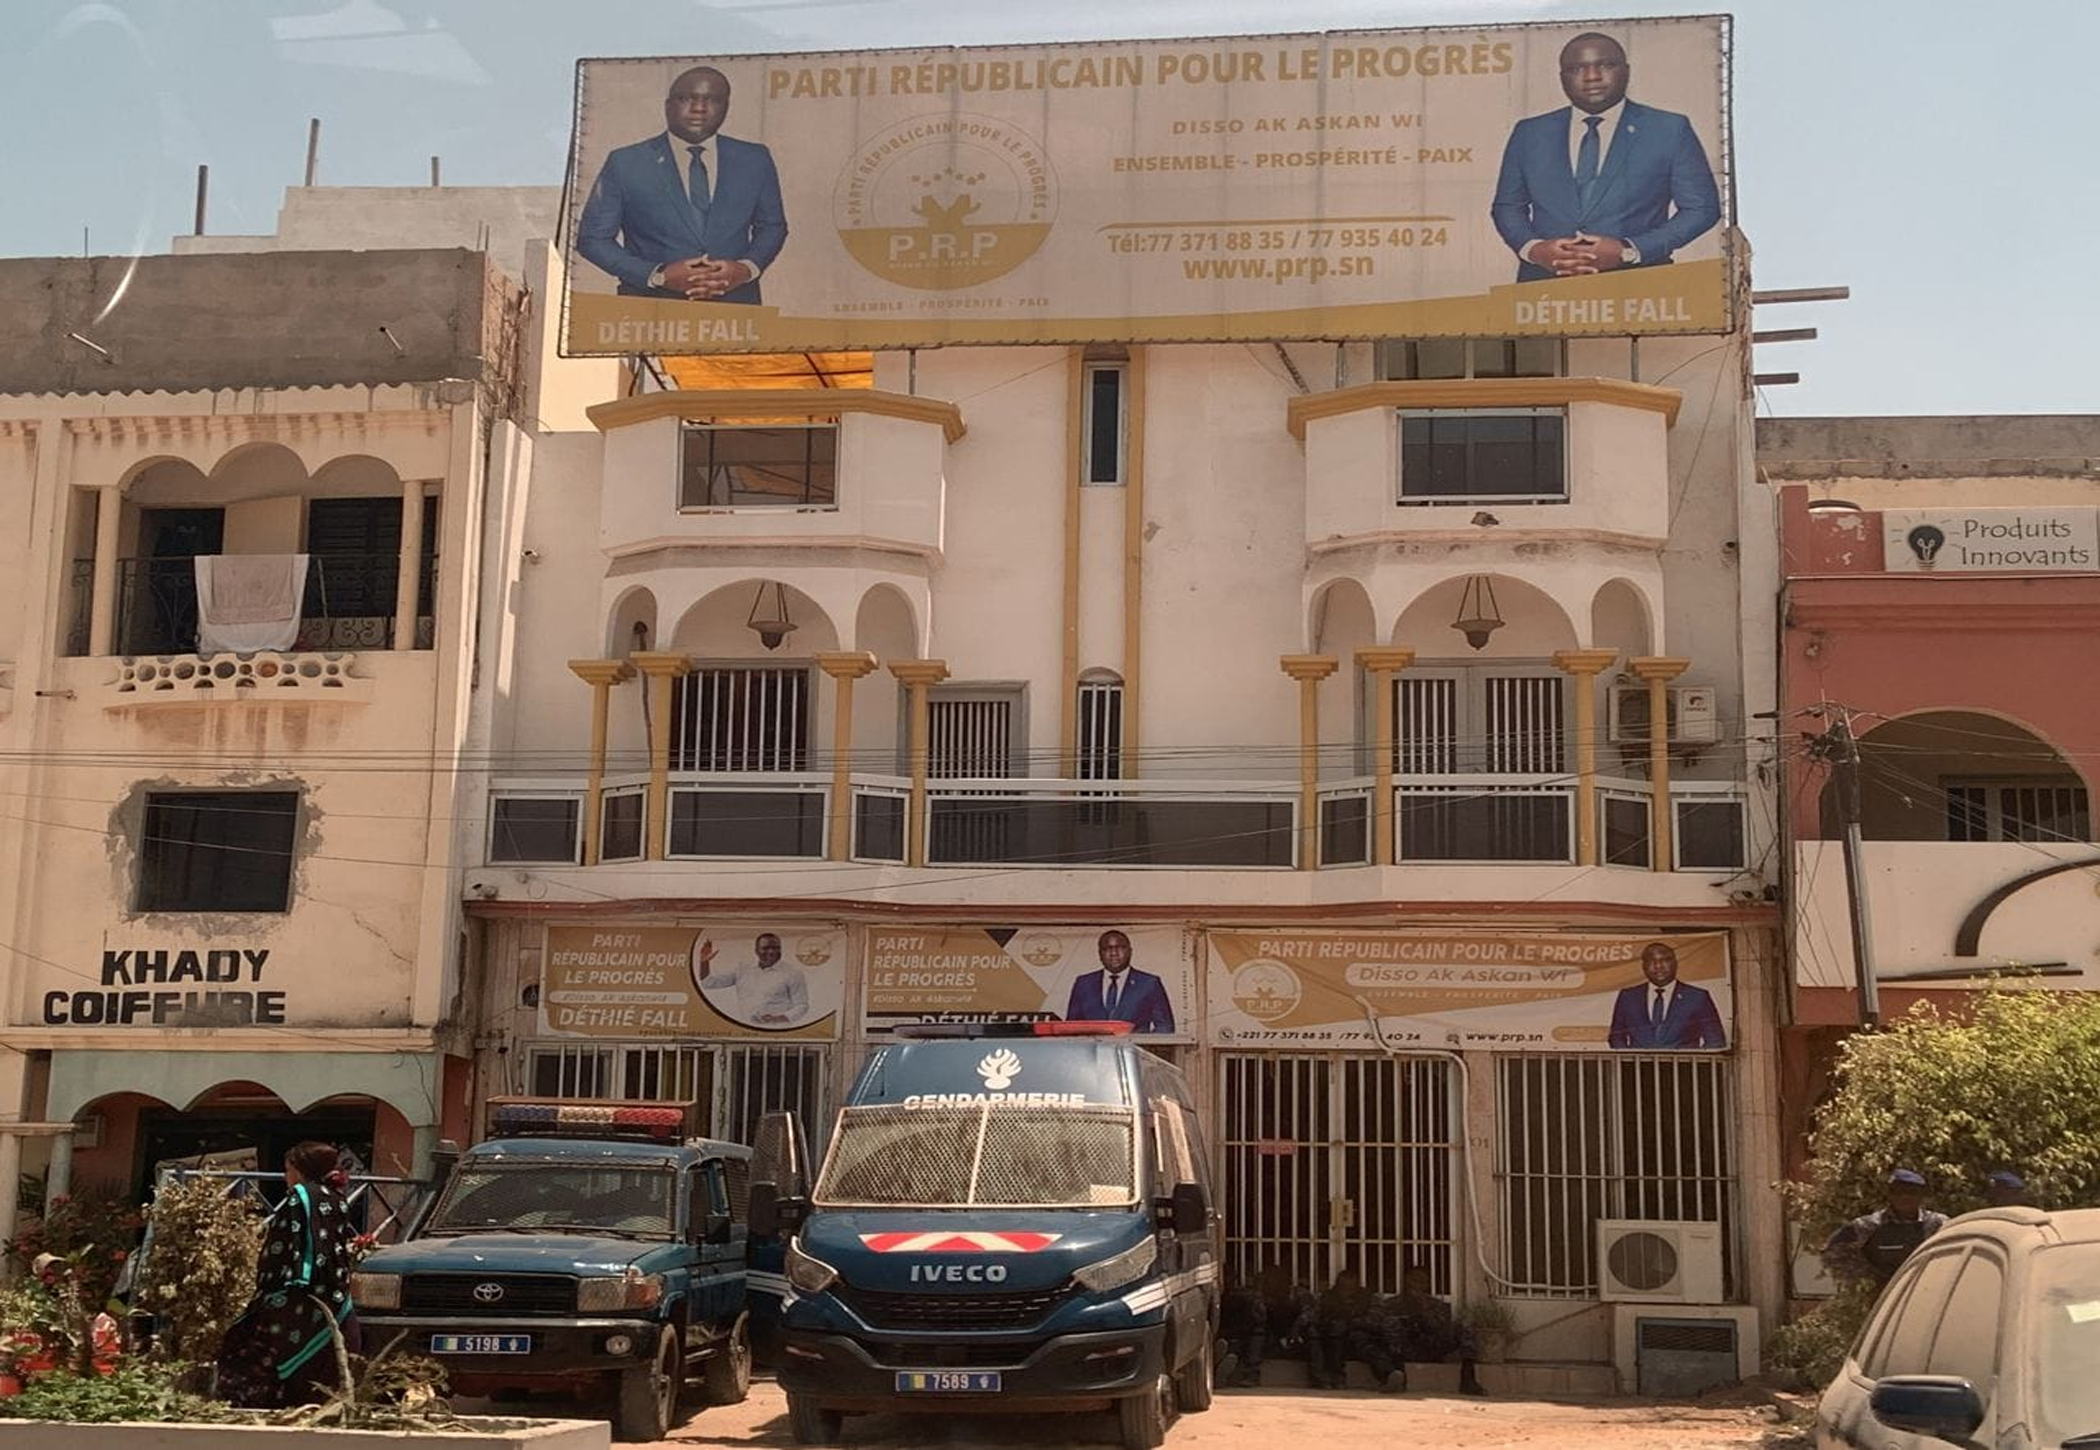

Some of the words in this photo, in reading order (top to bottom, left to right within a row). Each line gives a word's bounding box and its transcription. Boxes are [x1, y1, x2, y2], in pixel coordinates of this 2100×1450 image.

[769, 66, 878, 99] PARTI
[889, 54, 1143, 95] RÉPUBLICAIN
[1157, 51, 1266, 86] POUR
[1277, 49, 1319, 81] LE
[1331, 34, 1513, 79] PROGRÈS
[1172, 119, 1245, 135] DISSO
[1254, 117, 1288, 132] AK
[1295, 114, 1382, 131] ASKAN
[1390, 113, 1423, 129] WI
[958, 121, 1001, 142] POUR
[1002, 136, 1023, 154] LE
[1112, 154, 1237, 173] ENSEMBLE
[1255, 146, 1397, 169] PROSPÉRITÉ
[1416, 147, 1474, 165] PAIX
[889, 231, 998, 262] P.R.P
[1107, 232, 1174, 253] Tél:77
[1179, 232, 1219, 252] 371
[1225, 231, 1253, 251] 88
[1258, 230, 1285, 250] 35
[1290, 229, 1301, 249] /
[1307, 229, 1335, 249] 77
[1340, 228, 1381, 248] 935
[1387, 227, 1414, 247] 40
[1420, 226, 1448, 247] 24
[1182, 254, 1375, 286] www.prp.sn
[1515, 293, 1616, 325] DÉTHIE
[1623, 296, 1693, 323] FALL
[597, 314, 691, 345] DÉTHIE
[697, 318, 761, 343] FALL
[1963, 516, 2073, 540] Produits
[1960, 545, 2090, 566] Innovants
[591, 933, 643, 948] PARTI
[875, 936, 925, 951] PARTI
[1259, 940, 1314, 958] PARTI
[1318, 937, 1447, 960] RÉPUBLICAIN
[1451, 943, 1508, 961] POUR
[1513, 944, 1537, 961] LE
[101, 949, 270, 986] KHADY
[551, 948, 644, 967] RÉPUBLICAIN
[646, 952, 687, 968] POUR
[872, 953, 969, 970] RÉPUBLICAIN
[970, 955, 1012, 970] POUR
[563, 970, 585, 984] LE
[873, 972, 894, 987] LE
[1359, 966, 1419, 981] Disso
[1425, 968, 1455, 982] Ak
[1462, 969, 1532, 983] Askan
[640, 1010, 689, 1028] FALL
[1465, 1032, 1544, 1043] www.prp.sn
[903, 1092, 1087, 1110] GENDARMERIE
[910, 1264, 1008, 1283] IVECO
[464, 1336, 500, 1352] 5198
[932, 1373, 970, 1390] 7589
